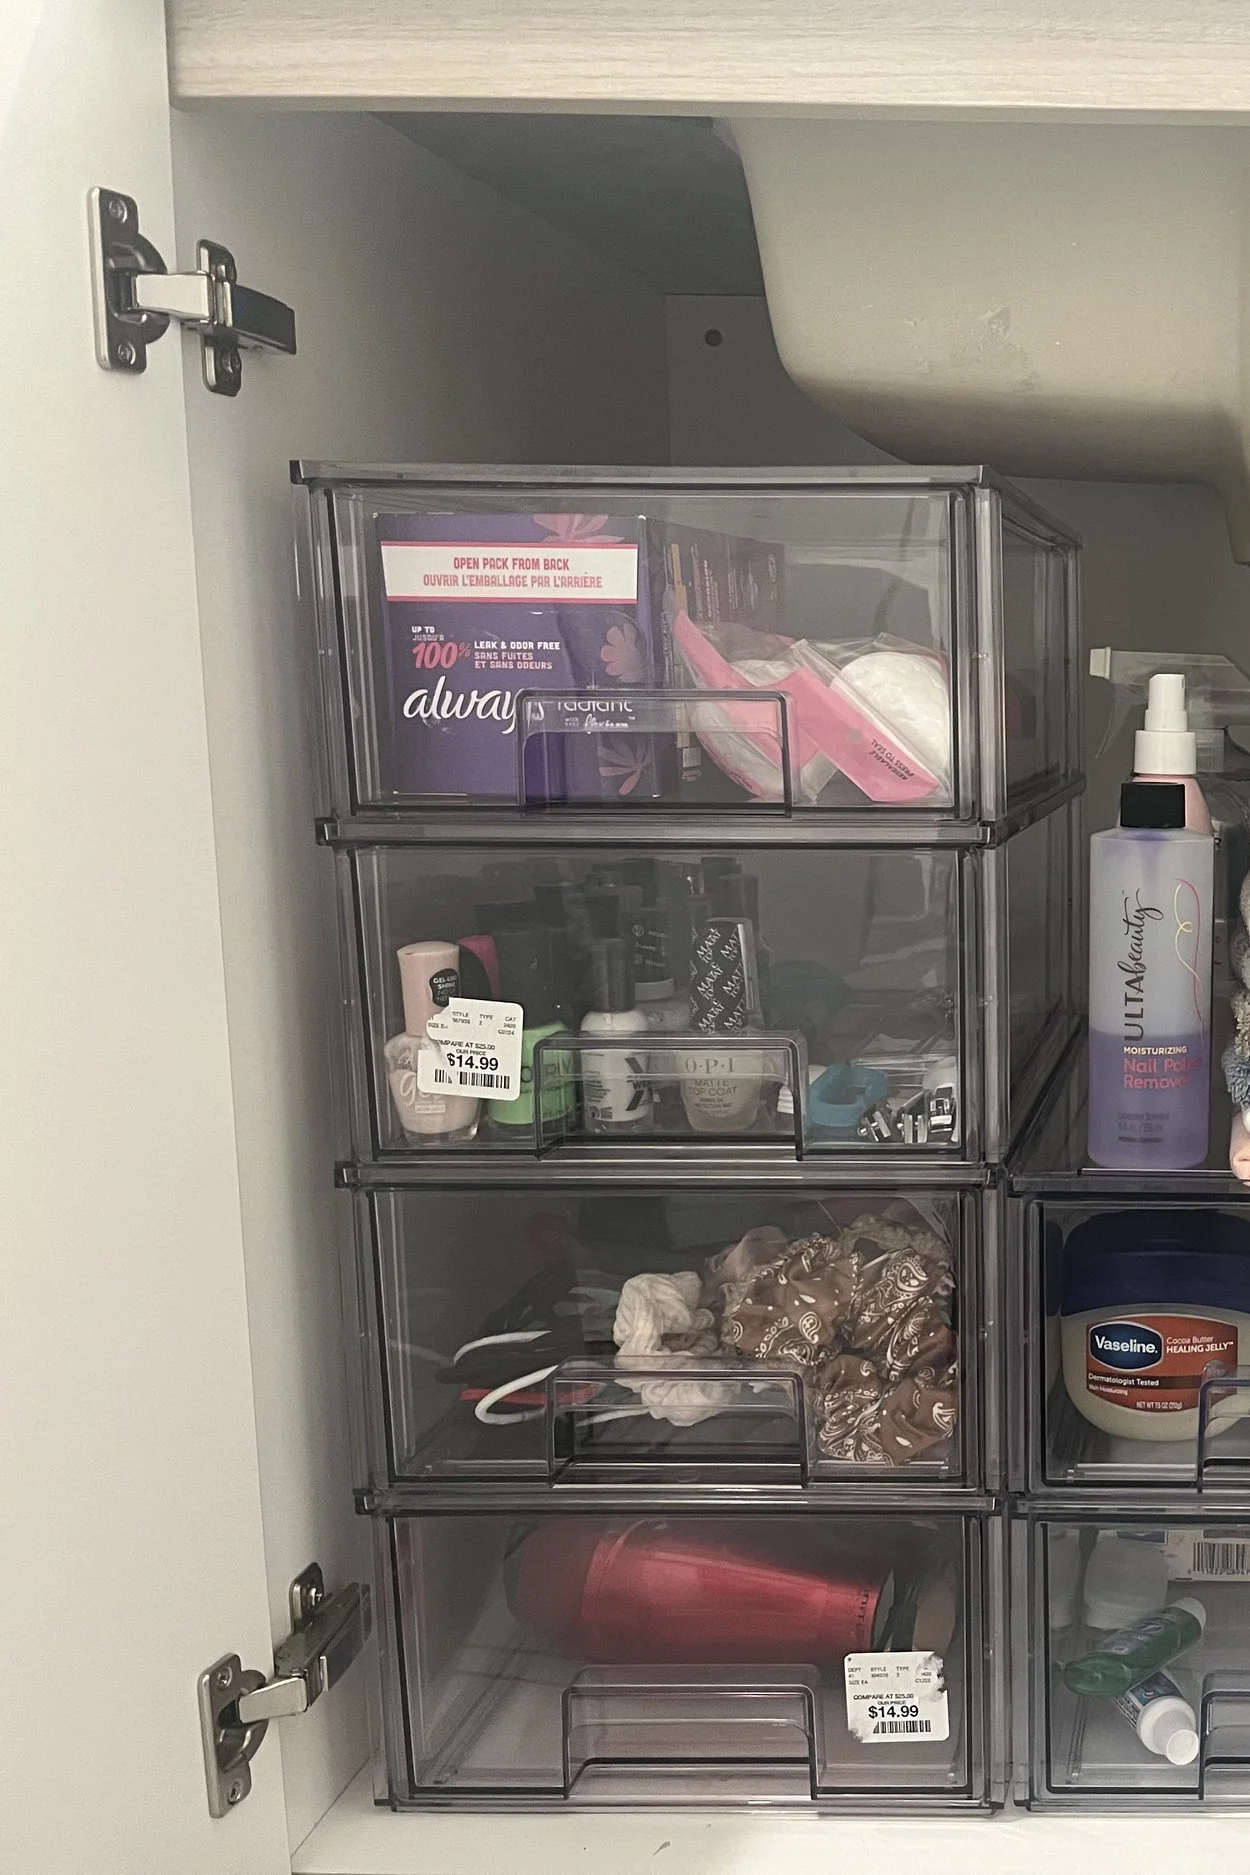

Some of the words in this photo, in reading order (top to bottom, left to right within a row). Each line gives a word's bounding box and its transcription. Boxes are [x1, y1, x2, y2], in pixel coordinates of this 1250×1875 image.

[453, 557, 480, 570] OPEN
[482, 557, 509, 570] PACK
[512, 558, 541, 571] FROM
[543, 558, 570, 571] BACK
[423, 574, 459, 587] OUVRIR
[461, 574, 528, 588] L'EMBALLAGE
[531, 575, 551, 588] PAR
[411, 626, 422, 634] UP
[424, 626, 435, 634] TO
[474, 641, 498, 650] LEAK
[500, 641, 507, 650] &
[510, 641, 535, 650] ODOR
[537, 641, 560, 650] FREE
[474, 651, 499, 660] SANS
[501, 651, 534, 660] FUITES
[474, 661, 486, 669] ET
[489, 661, 515, 669] SANS
[517, 661, 552, 670] ODEURS
[1123, 1046, 1188, 1055] MOISTURIZING
[446, 1053, 499, 1072] $14.99
[1124, 1058, 1157, 1073] Nail
[708, 1086, 737, 1096] COAT
[1166, 1336, 1191, 1345] Cocoa
[1192, 1336, 1214, 1344] Butter
[1166, 1344, 1204, 1354] HEALING
[1088, 1373, 1135, 1386] Dermatologist
[1136, 1378, 1160, 1387] Tested
[868, 1705, 919, 1719] $14.99
